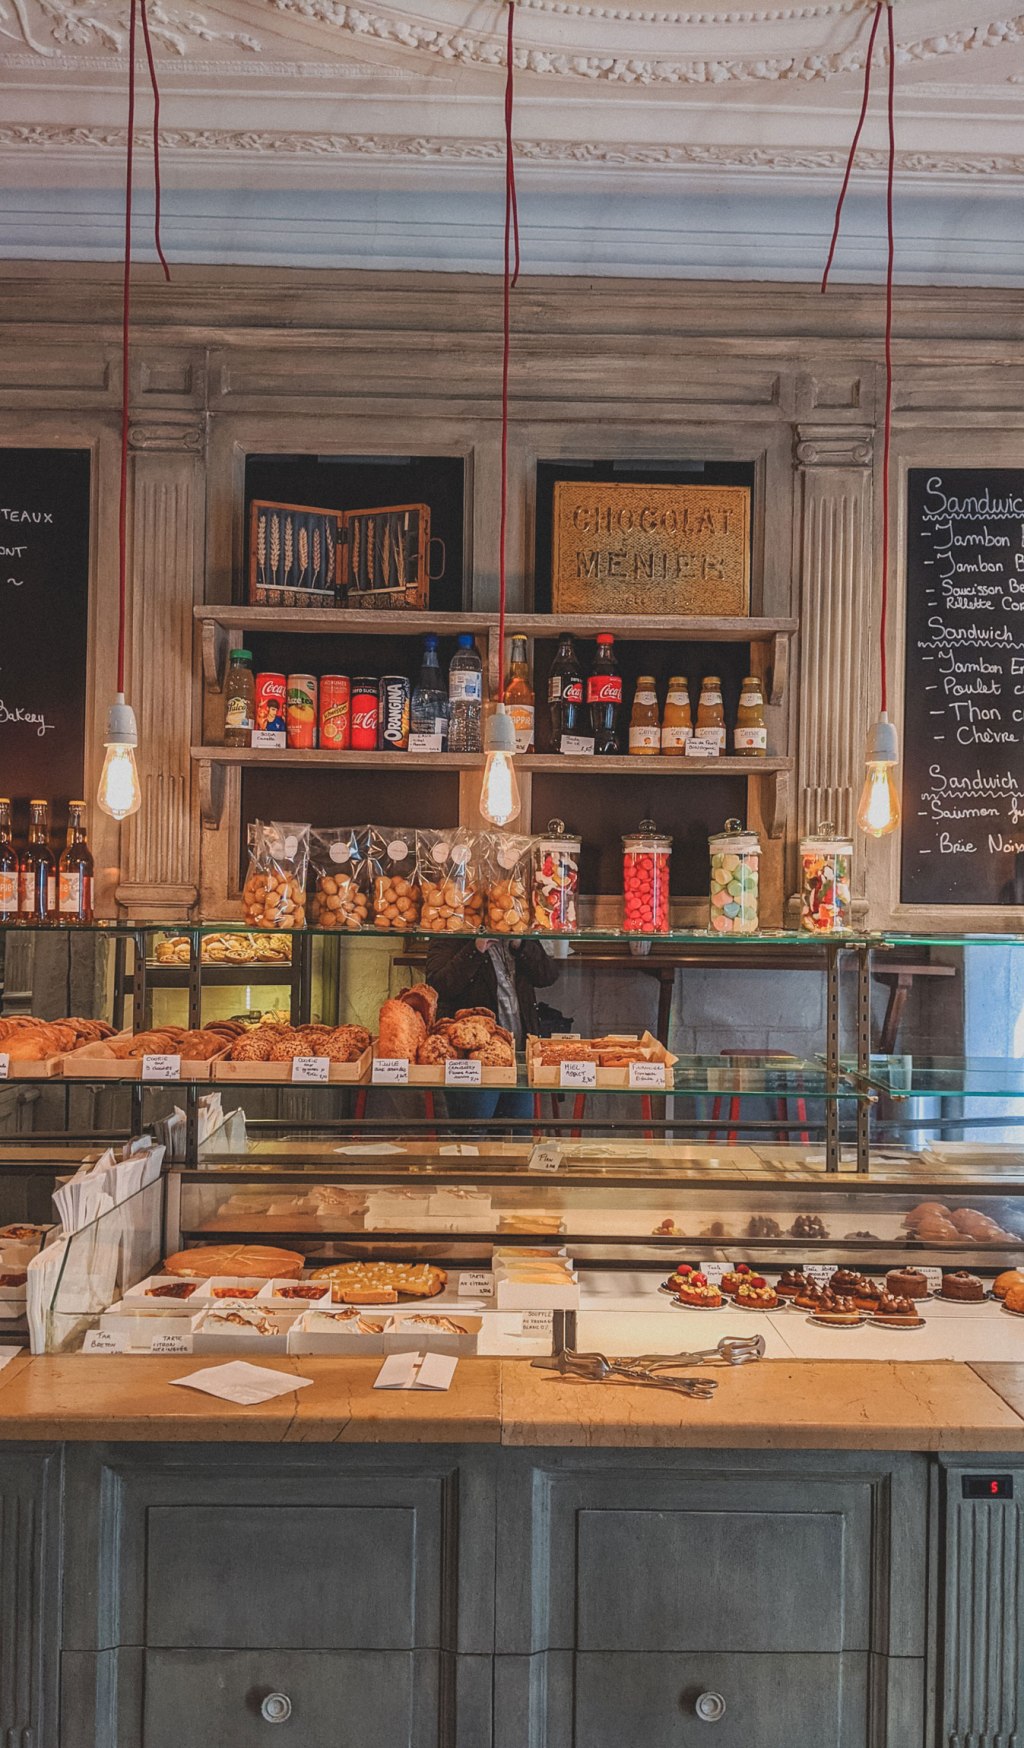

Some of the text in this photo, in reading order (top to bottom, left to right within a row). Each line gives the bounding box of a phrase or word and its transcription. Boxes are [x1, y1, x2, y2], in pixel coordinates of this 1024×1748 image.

[573, 506, 734, 535] CHOCOLAT
[933, 520, 1010, 549] Jambon
[576, 551, 725, 580] MENIER
[937, 551, 1004, 578] Jambon
[928, 616, 1013, 640] Sandwich
[938, 649, 1003, 673] Jambon
[944, 676, 1001, 696] Poulet
[384, 684, 402, 741] ORANGINA
[949, 700, 1001, 723] Thon
[929, 764, 1018, 791] Sandwich
[931, 800, 1000, 820] Saumon
[940, 832, 977, 853] Brie
